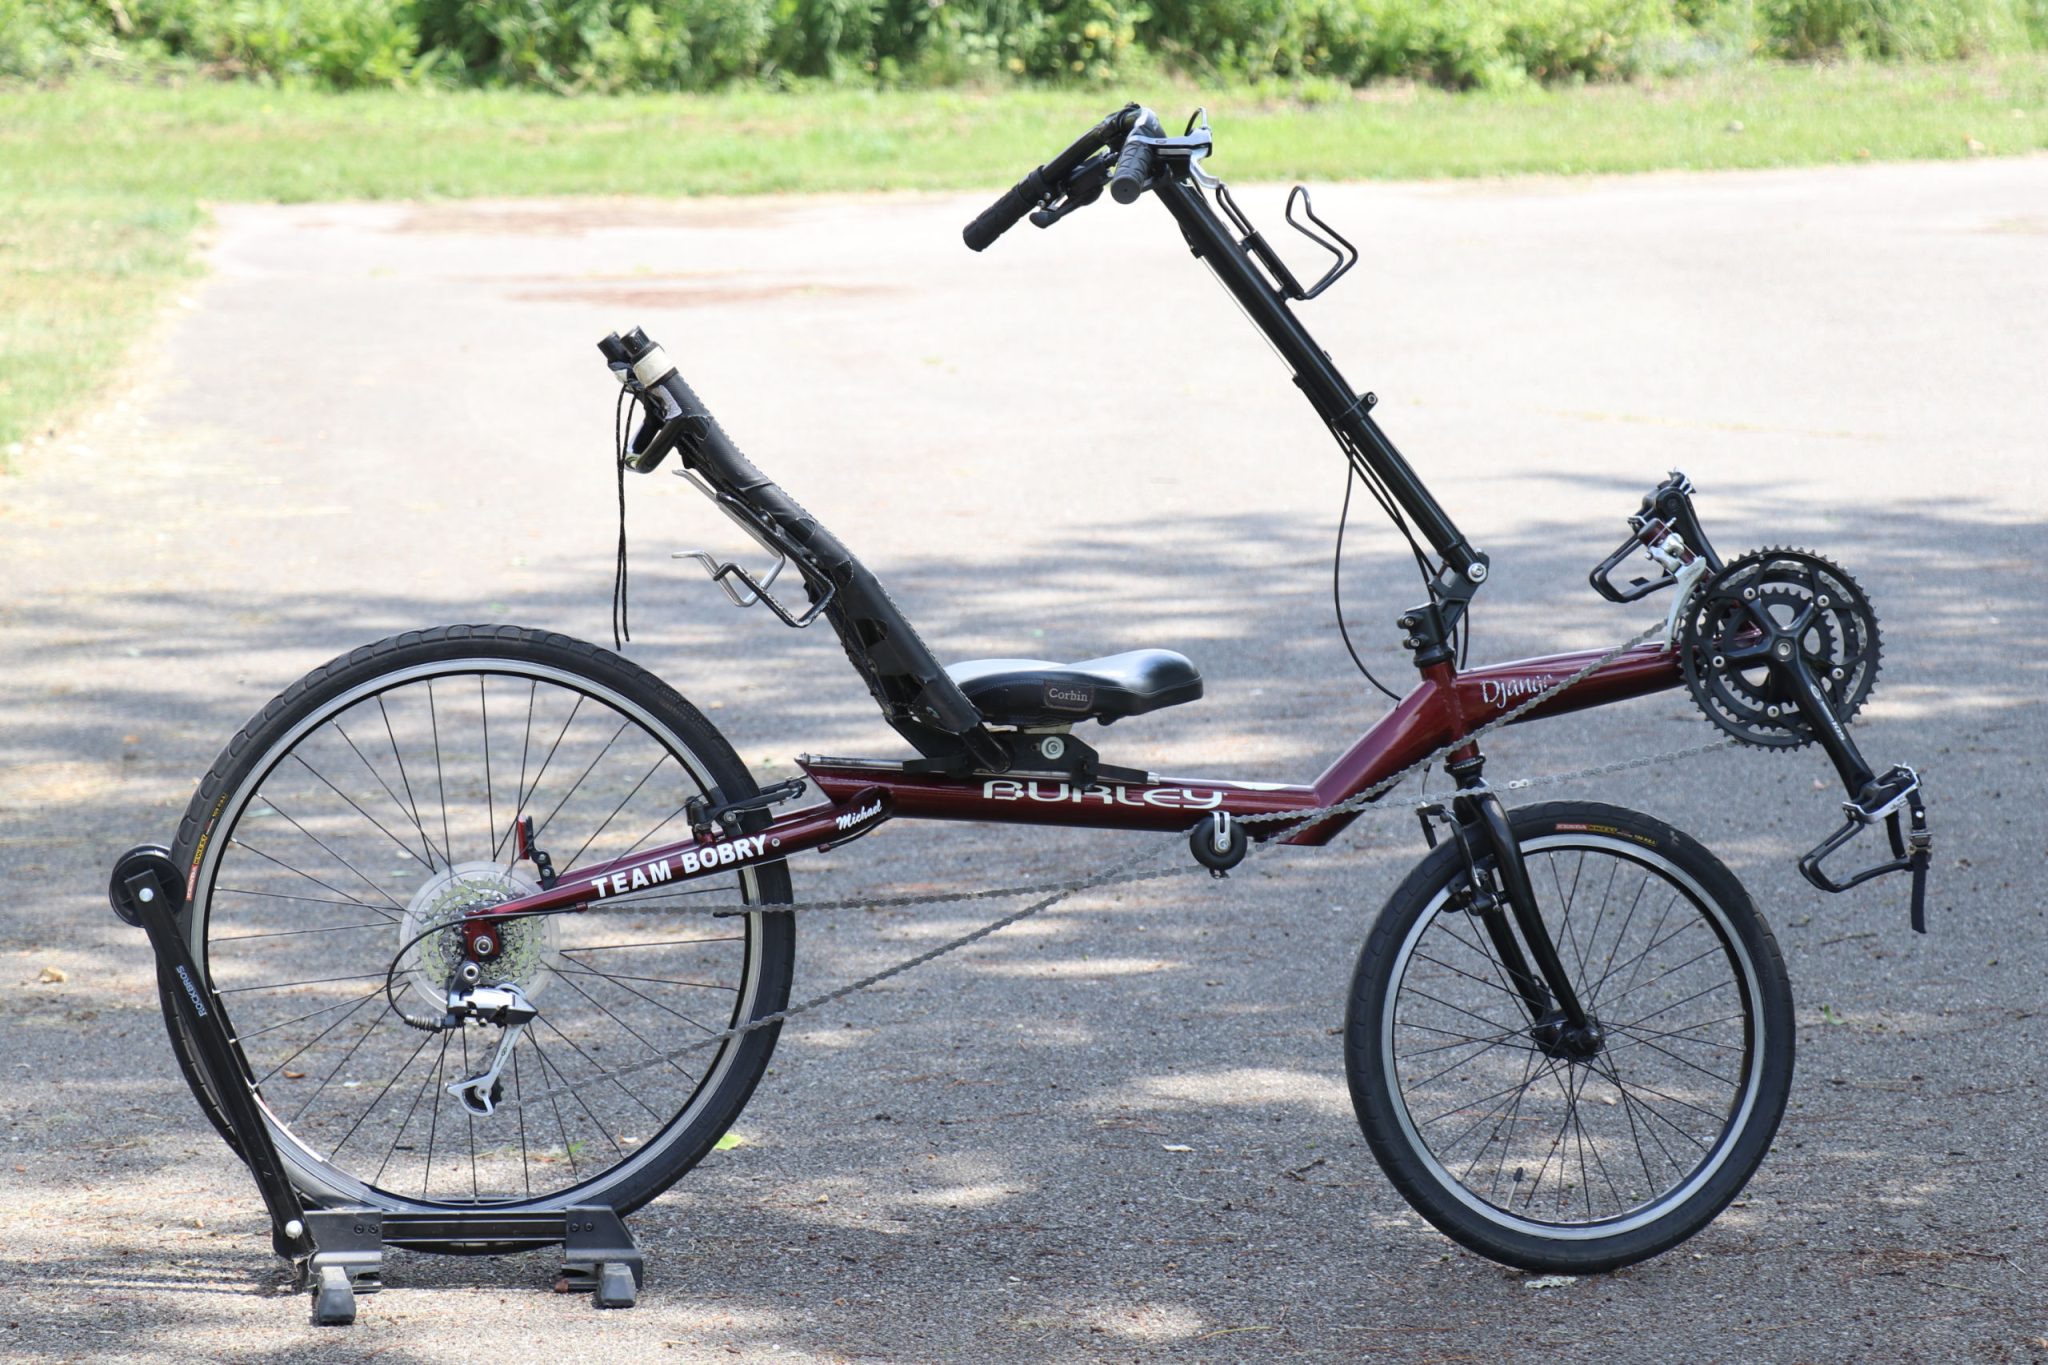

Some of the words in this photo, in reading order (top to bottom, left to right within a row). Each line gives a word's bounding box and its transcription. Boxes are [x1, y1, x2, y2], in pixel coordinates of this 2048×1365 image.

[1049, 687, 1089, 702] Corbin
[983, 780, 1228, 810] BURLEY
[836, 800, 882, 830] Michael
[591, 860, 672, 898] TEAM
[681, 834, 767, 874] BOBRY
[175, 964, 208, 1017] ROCKBROS
